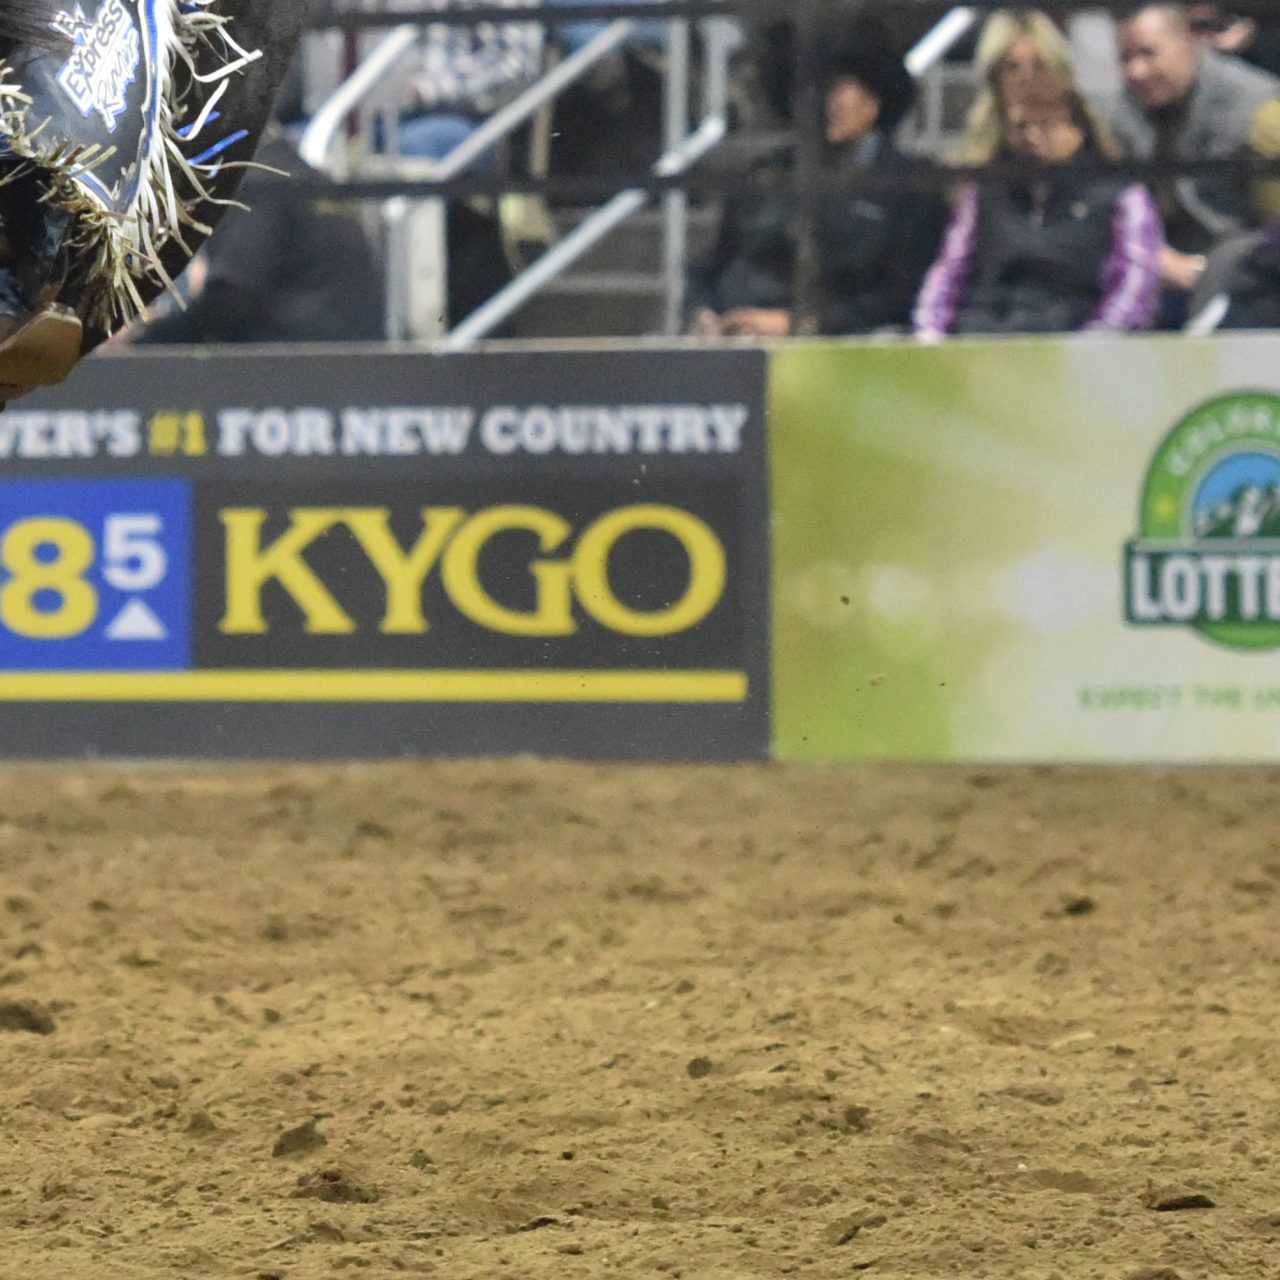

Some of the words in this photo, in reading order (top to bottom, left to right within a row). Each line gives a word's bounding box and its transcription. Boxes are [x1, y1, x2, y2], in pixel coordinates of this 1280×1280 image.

[218, 406, 333, 456] FOR
[338, 406, 475, 455] NEW
[479, 405, 749, 454] COUNTRY
[219, 504, 726, 637] KYGO
